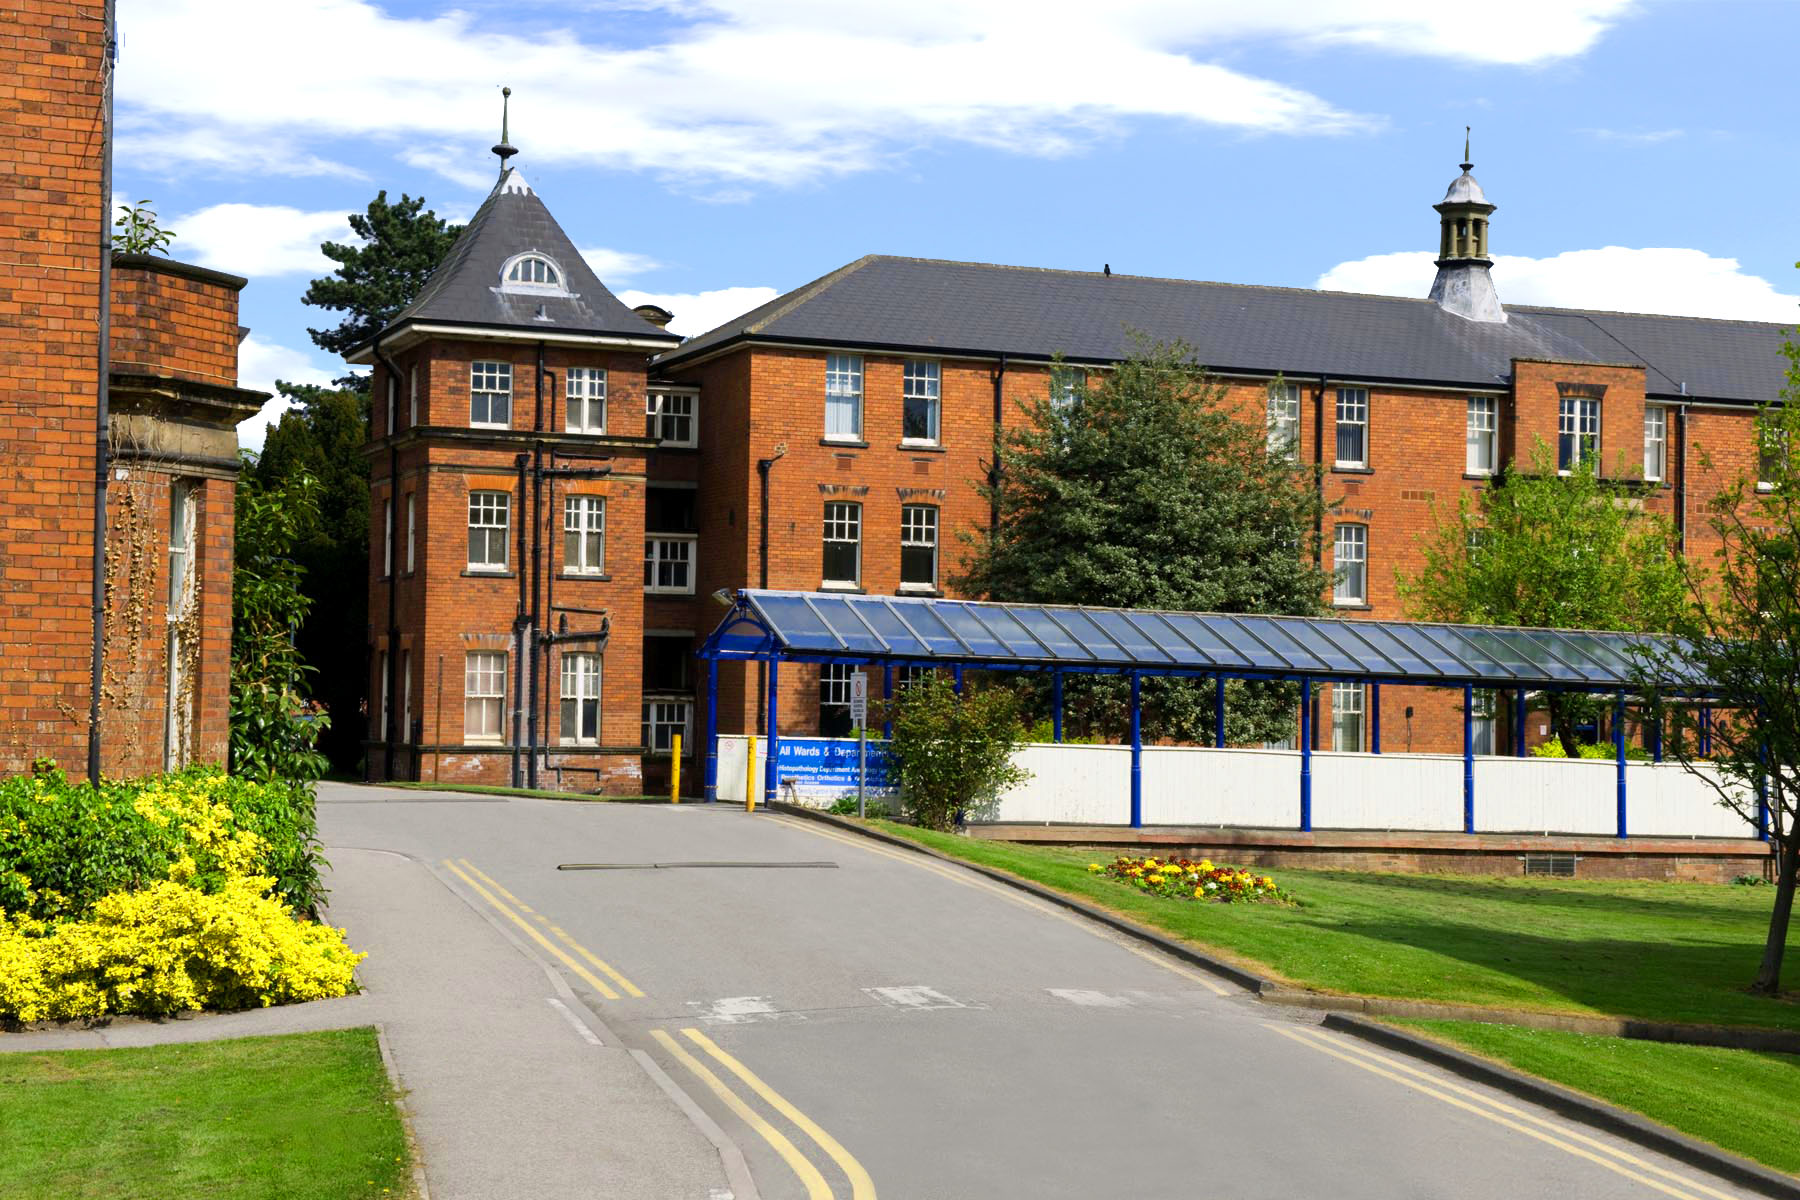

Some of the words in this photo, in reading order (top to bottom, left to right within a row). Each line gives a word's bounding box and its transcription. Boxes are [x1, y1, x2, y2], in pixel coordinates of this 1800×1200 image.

[779, 746, 790, 756] All
[794, 746, 820, 756] Wards
[824, 746, 830, 757] &
[834, 747, 889, 759] Deparment
[819, 766, 850, 774] Department
